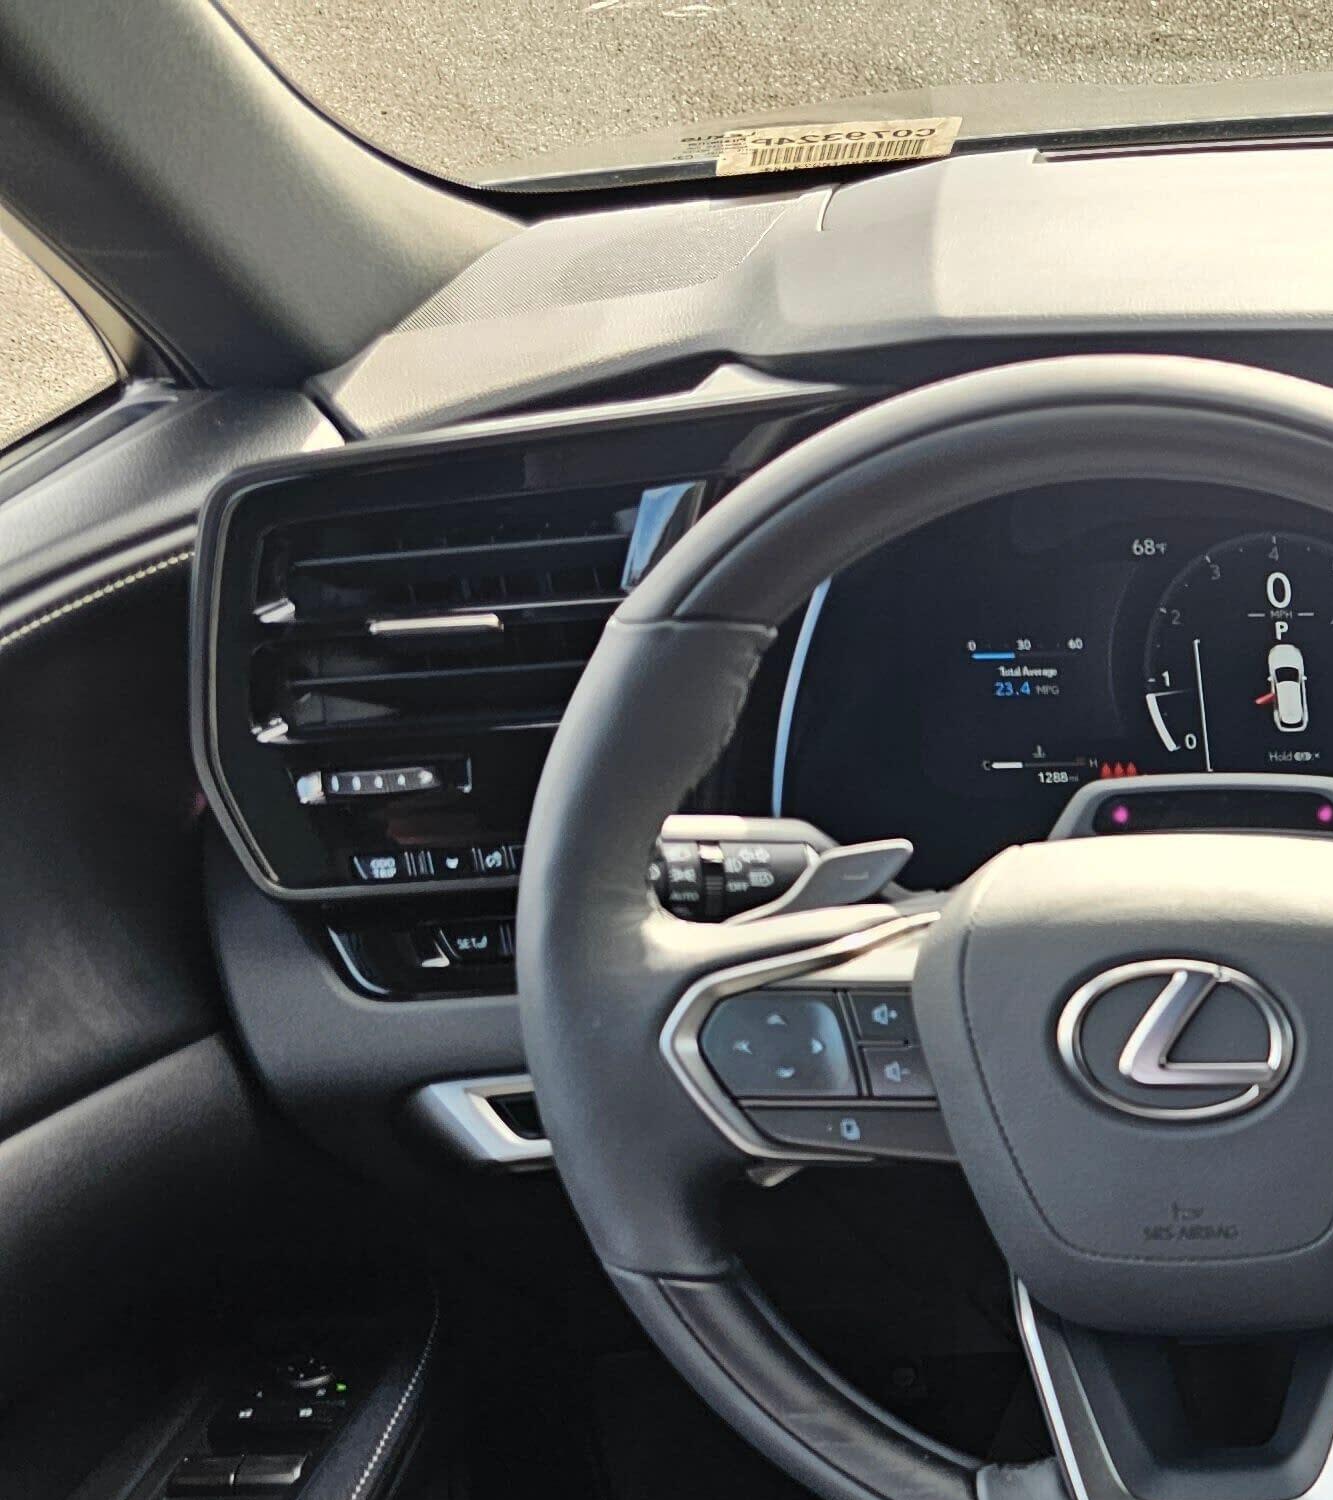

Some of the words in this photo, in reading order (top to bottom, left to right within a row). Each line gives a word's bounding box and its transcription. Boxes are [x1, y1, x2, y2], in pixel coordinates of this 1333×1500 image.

[1268, 546, 1280, 561] 4
[1209, 563, 1222, 581] 3
[1266, 572, 1292, 609] 0
[1171, 609, 1183, 625] 2
[1274, 621, 1289, 640] P
[1016, 639, 1032, 651] 30
[1066, 638, 1083, 650] 60
[1022, 666, 1058, 678] Average
[1161, 671, 1171, 687] 1
[994, 681, 1031, 697] 23.4
[1036, 686, 1060, 696] MPG
[1185, 733, 1197, 749] 0
[1269, 751, 1293, 762] Hold
[1038, 771, 1069, 784] 1288
